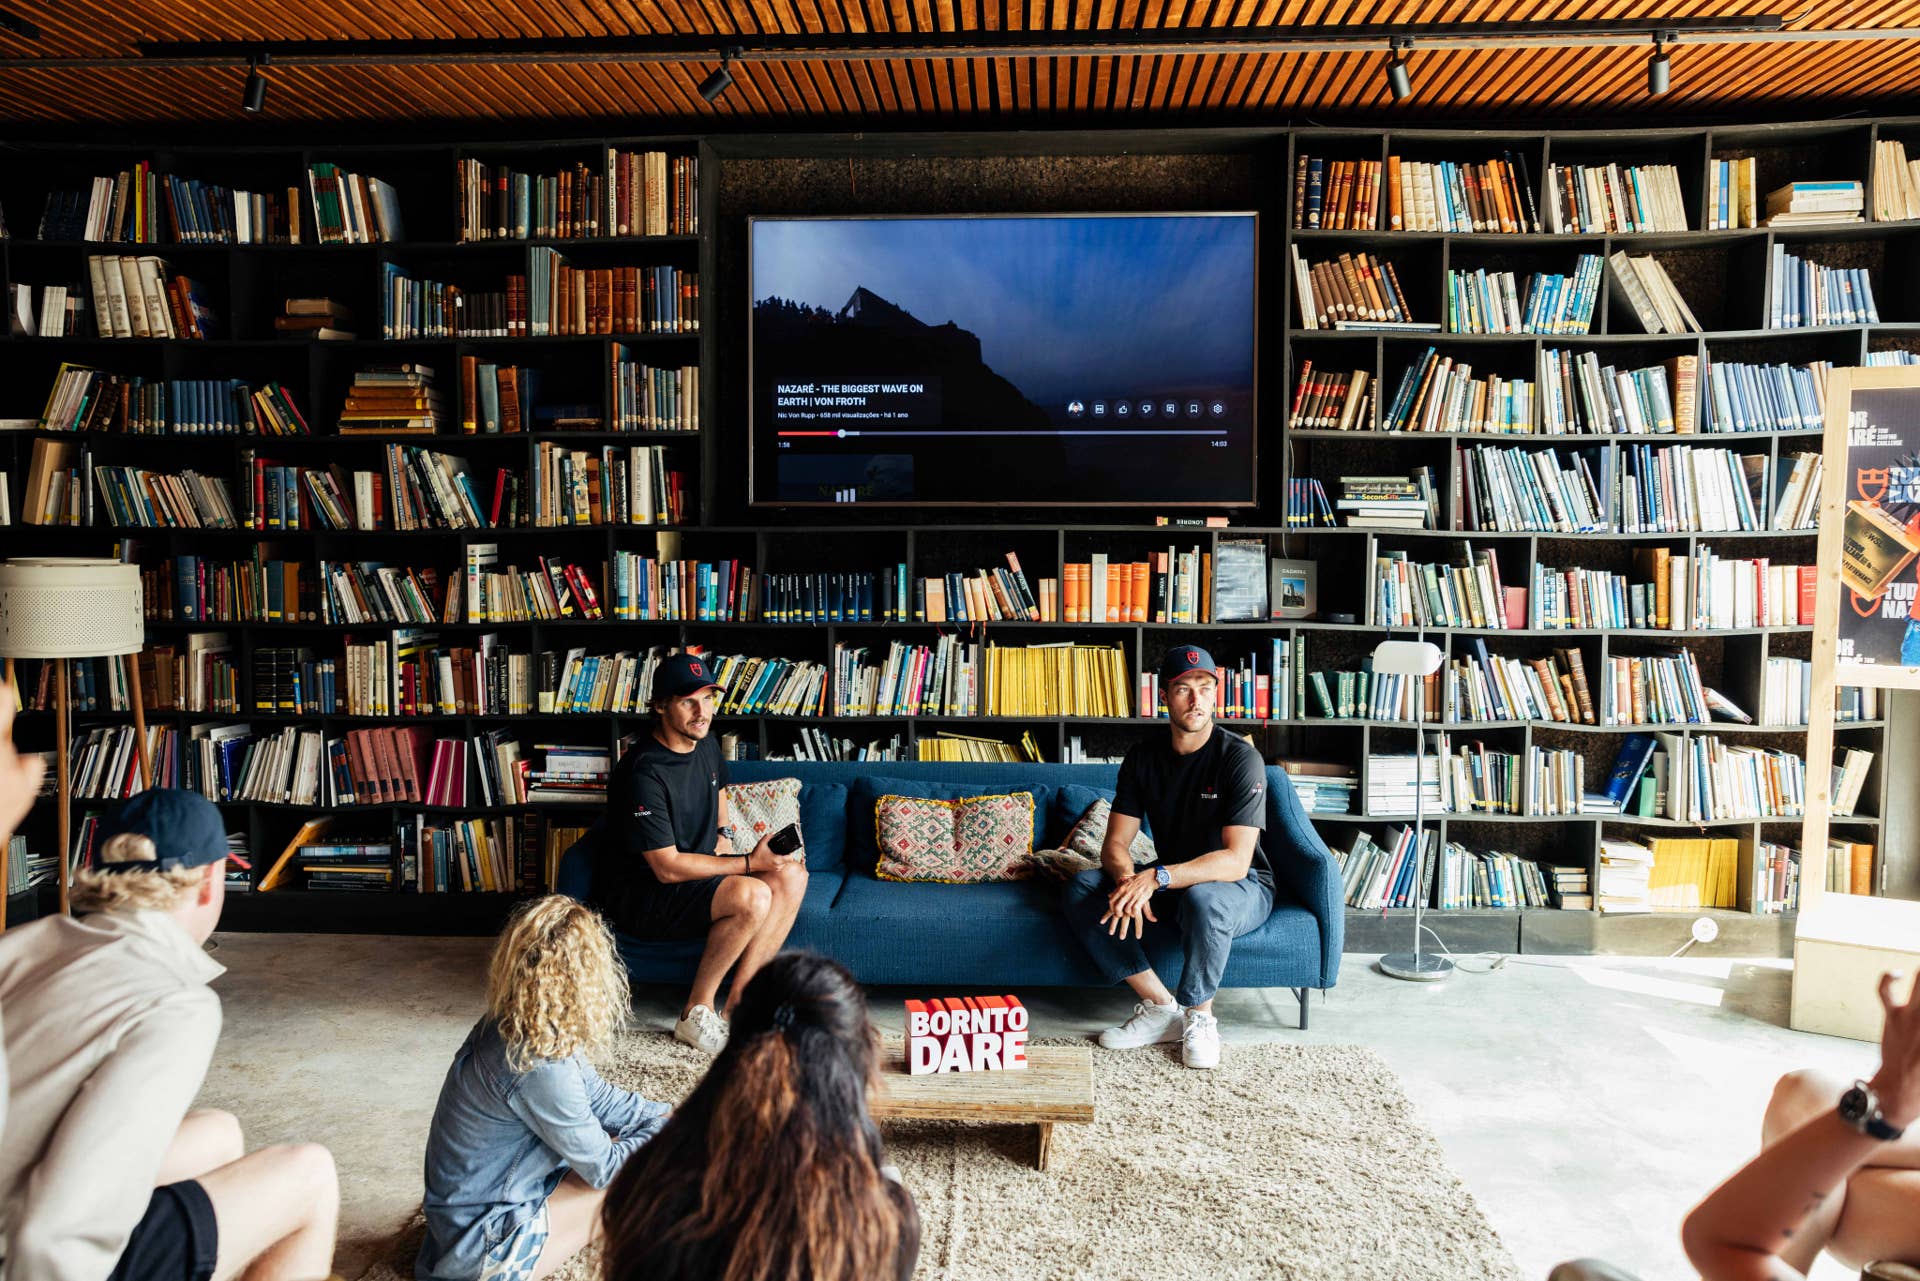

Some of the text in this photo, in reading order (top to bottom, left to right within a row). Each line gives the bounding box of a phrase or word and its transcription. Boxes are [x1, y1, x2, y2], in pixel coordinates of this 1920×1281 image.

[777, 383, 814, 394] NAZARÉ
[821, 384, 840, 393] THE
[841, 384, 880, 393] BIGGEST
[881, 384, 908, 393] WAVE
[909, 384, 924, 393] ON
[777, 397, 808, 406] EARTH
[814, 397, 833, 406] VON
[835, 397, 866, 406] FROTH
[801, 412, 816, 420] Rupp
[1016, 574, 1027, 590] PARIS
[911, 1031, 1029, 1076] DARE
